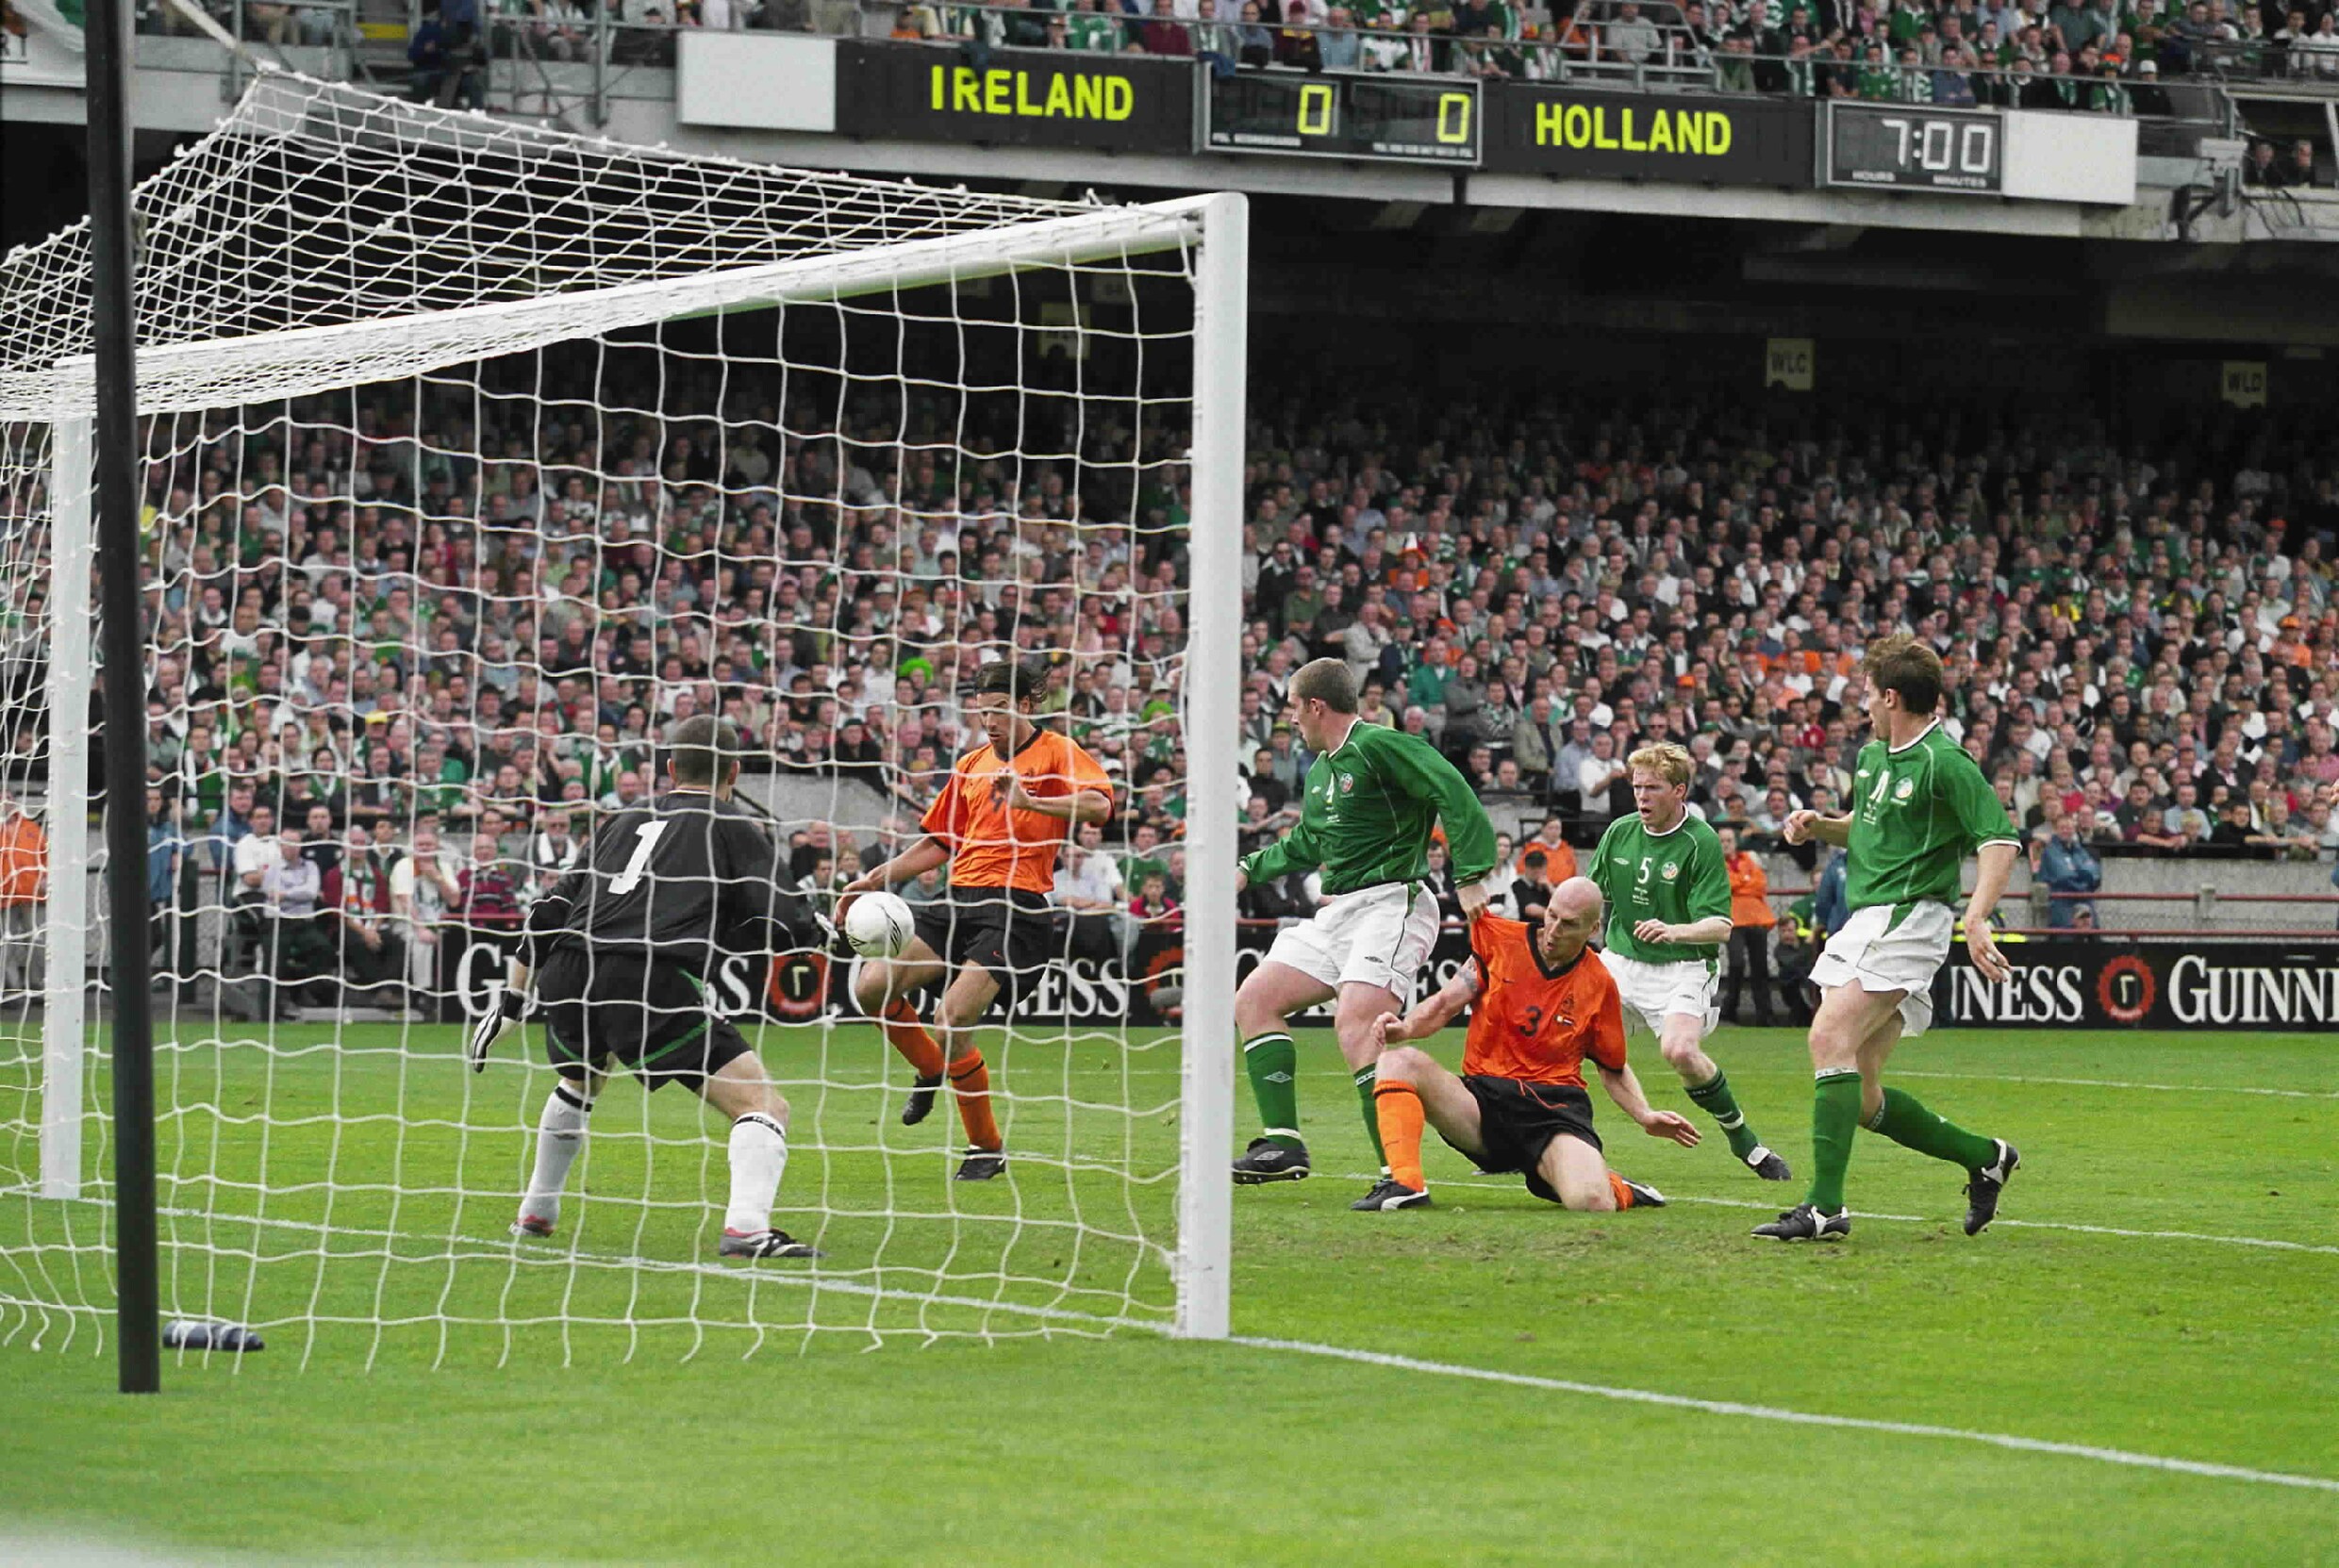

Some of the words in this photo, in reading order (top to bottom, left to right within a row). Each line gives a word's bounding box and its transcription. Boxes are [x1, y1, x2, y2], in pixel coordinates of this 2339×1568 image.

[931, 64, 1134, 122] IRELAND
[1297, 84, 1333, 135] 0
[1436, 92, 1471, 143] 0
[1535, 102, 1732, 156] HOLLAND
[1882, 118, 1993, 173] 7:00
[607, 820, 669, 895] 1
[1637, 857, 1652, 884] 5
[1519, 1005, 1543, 1037] 3
